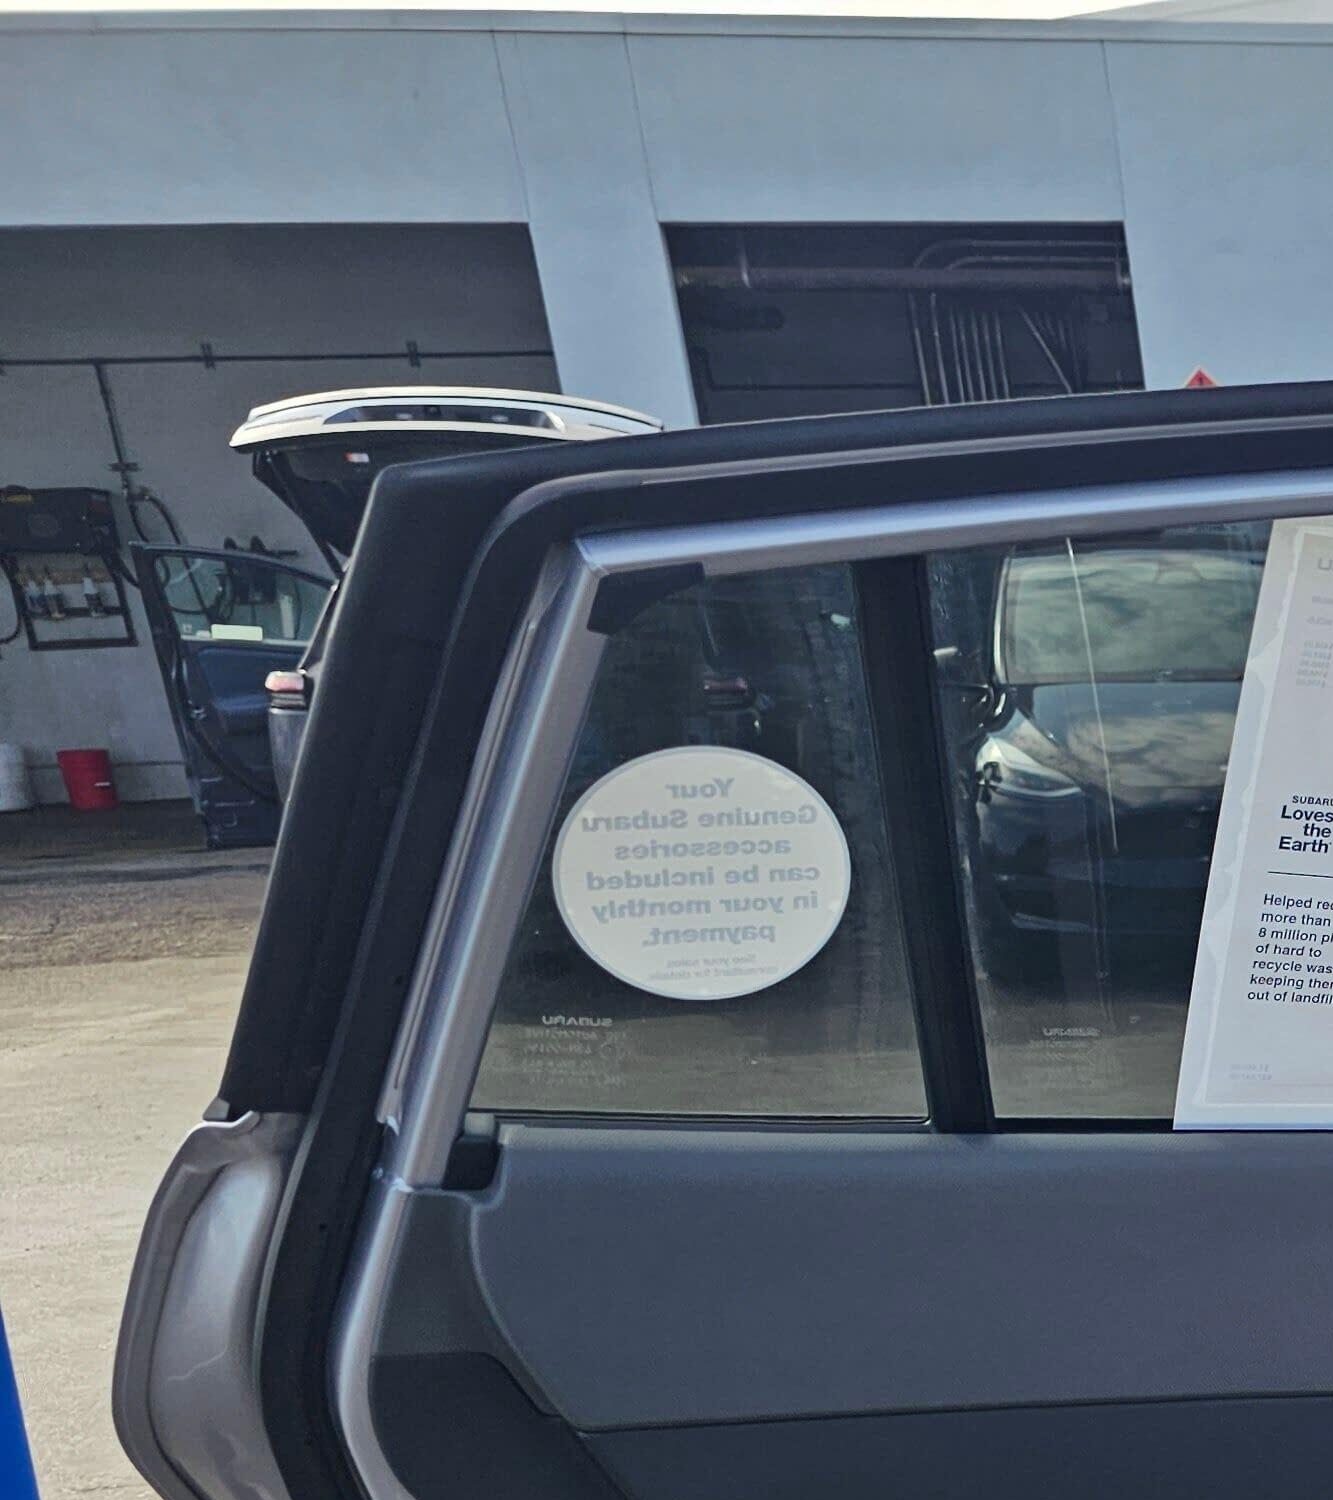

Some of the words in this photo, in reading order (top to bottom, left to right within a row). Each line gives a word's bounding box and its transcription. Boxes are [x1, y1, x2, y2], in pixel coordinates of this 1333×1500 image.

[1281, 805, 1333, 823] Loves
[1303, 823, 1331, 838] the
[1279, 836, 1328, 853] Earth
[1264, 894, 1312, 909] Helped
[1261, 913, 1296, 923] more
[1302, 915, 1330, 926] than
[1259, 928, 1266, 937] 8
[1271, 929, 1316, 942] million
[1256, 944, 1269, 954] of
[1274, 944, 1305, 956] hard
[1310, 947, 1321, 957] to
[1253, 961, 1302, 972] recycle
[1250, 974, 1304, 989] keeping
[1248, 992, 1269, 1000] out
[1274, 992, 1287, 1001] of
